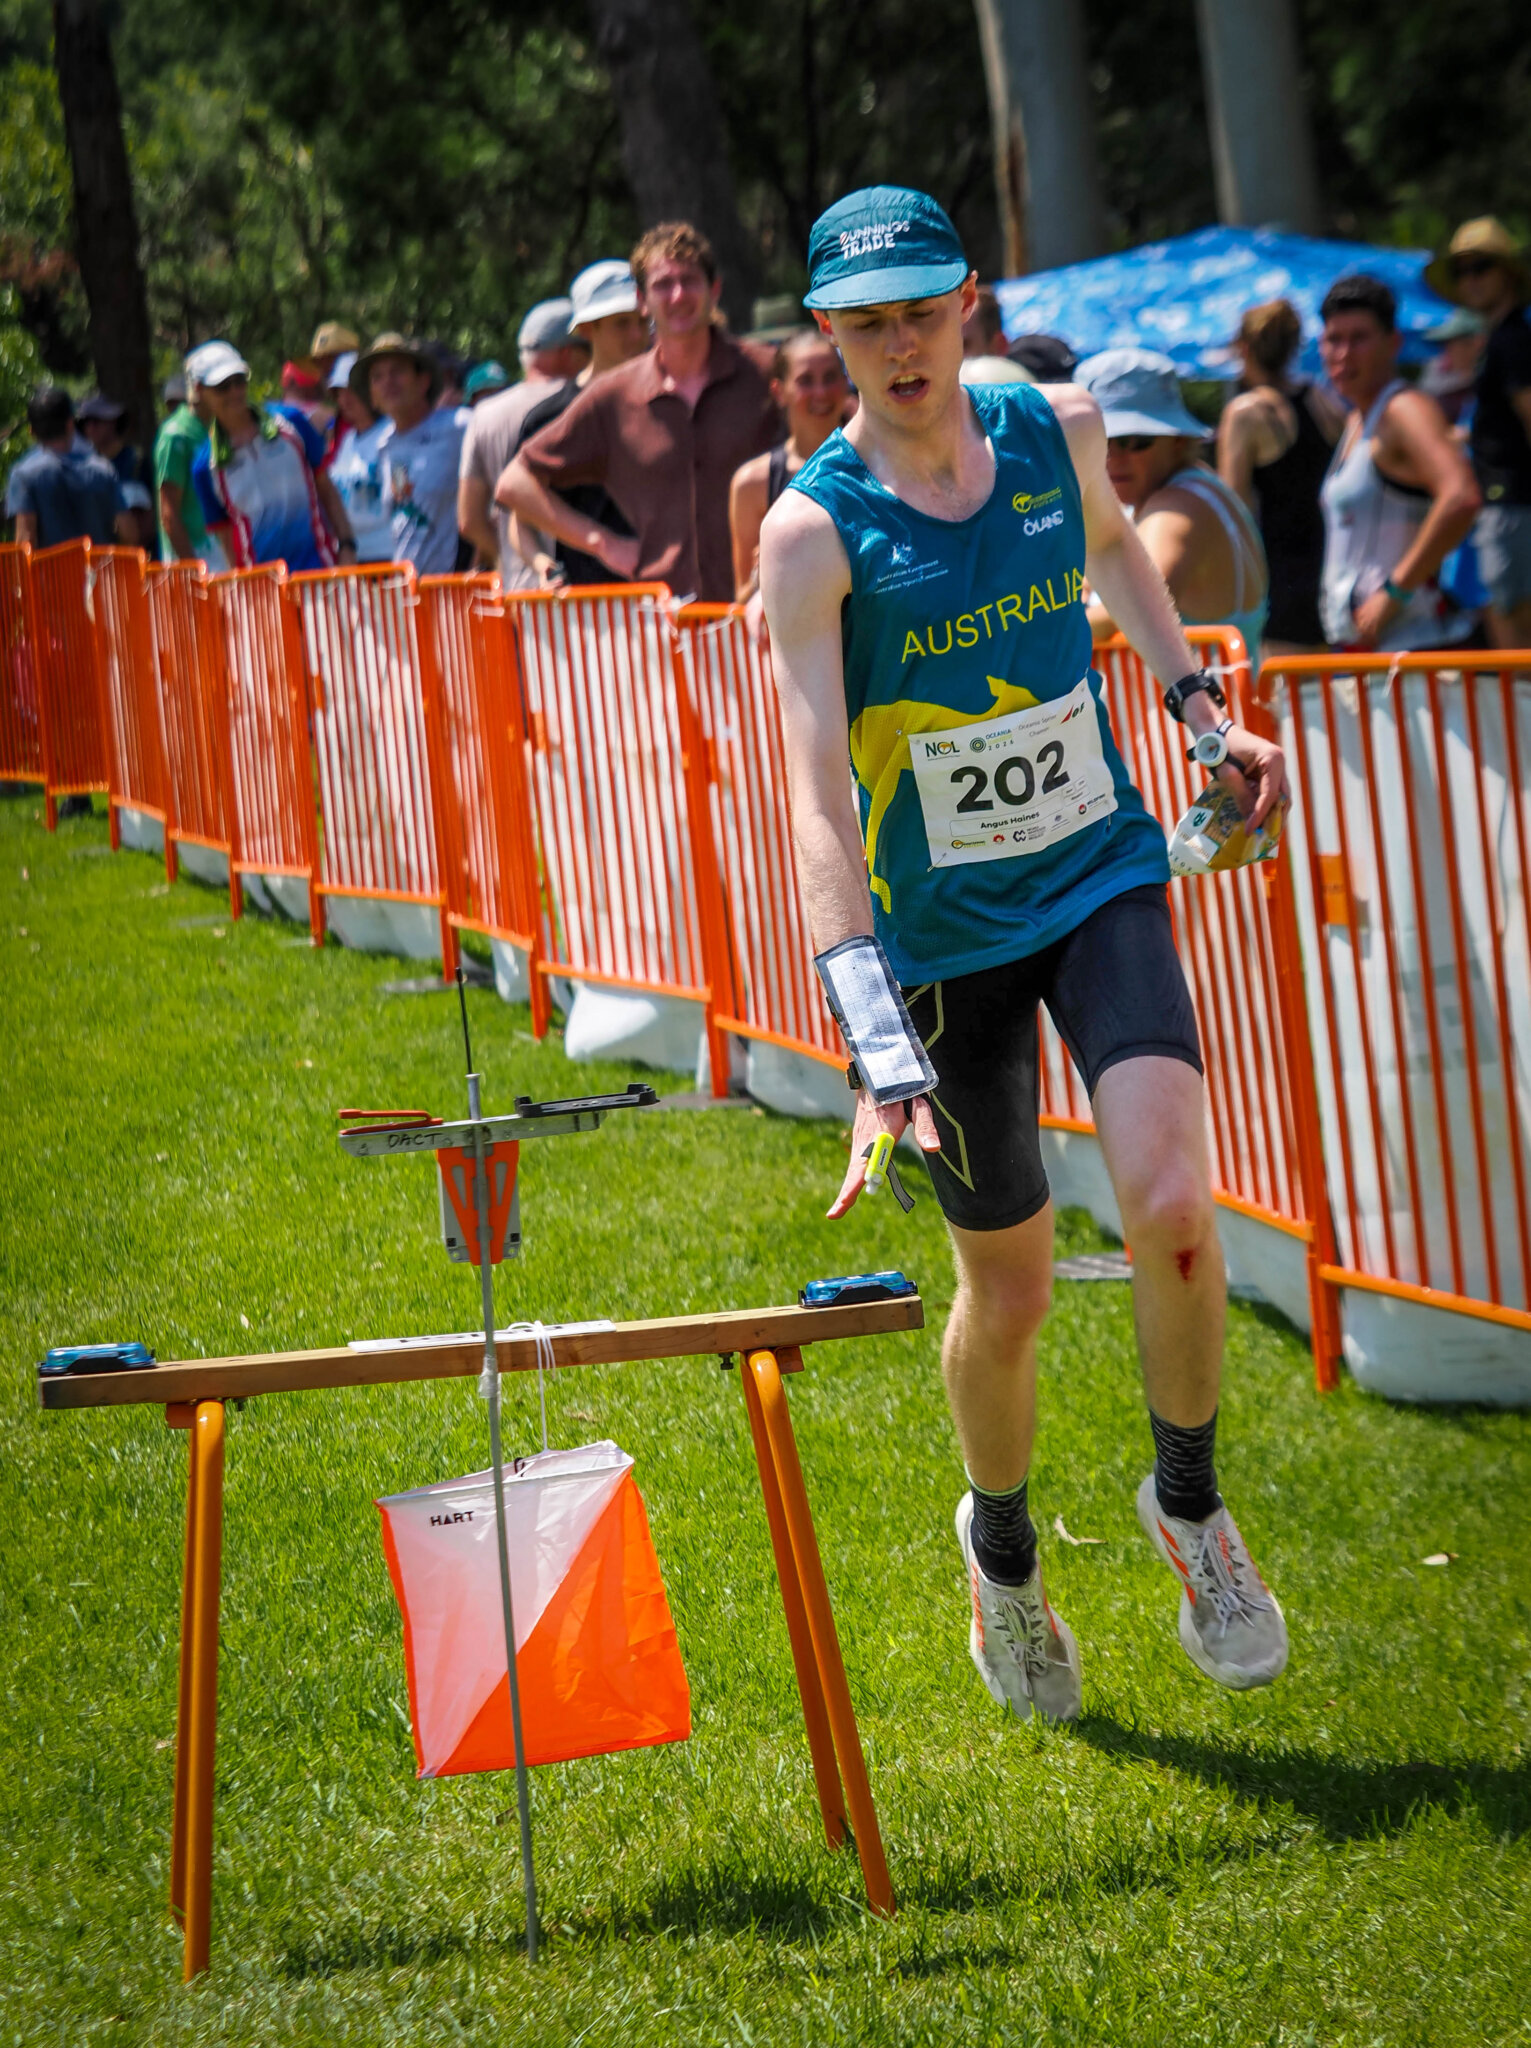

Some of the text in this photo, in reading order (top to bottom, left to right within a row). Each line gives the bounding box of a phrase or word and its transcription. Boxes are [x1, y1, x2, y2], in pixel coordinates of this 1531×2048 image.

[841, 232, 896, 260] TRADE
[901, 567, 1084, 664] AUSTRALIA
[985, 728, 1012, 740] OCEANIA
[925, 740, 960, 757] NOL
[950, 740, 1071, 814] 202
[980, 817, 1009, 830] Angus
[1010, 811, 1040, 825] Haines
[430, 1510, 474, 1527] HART
